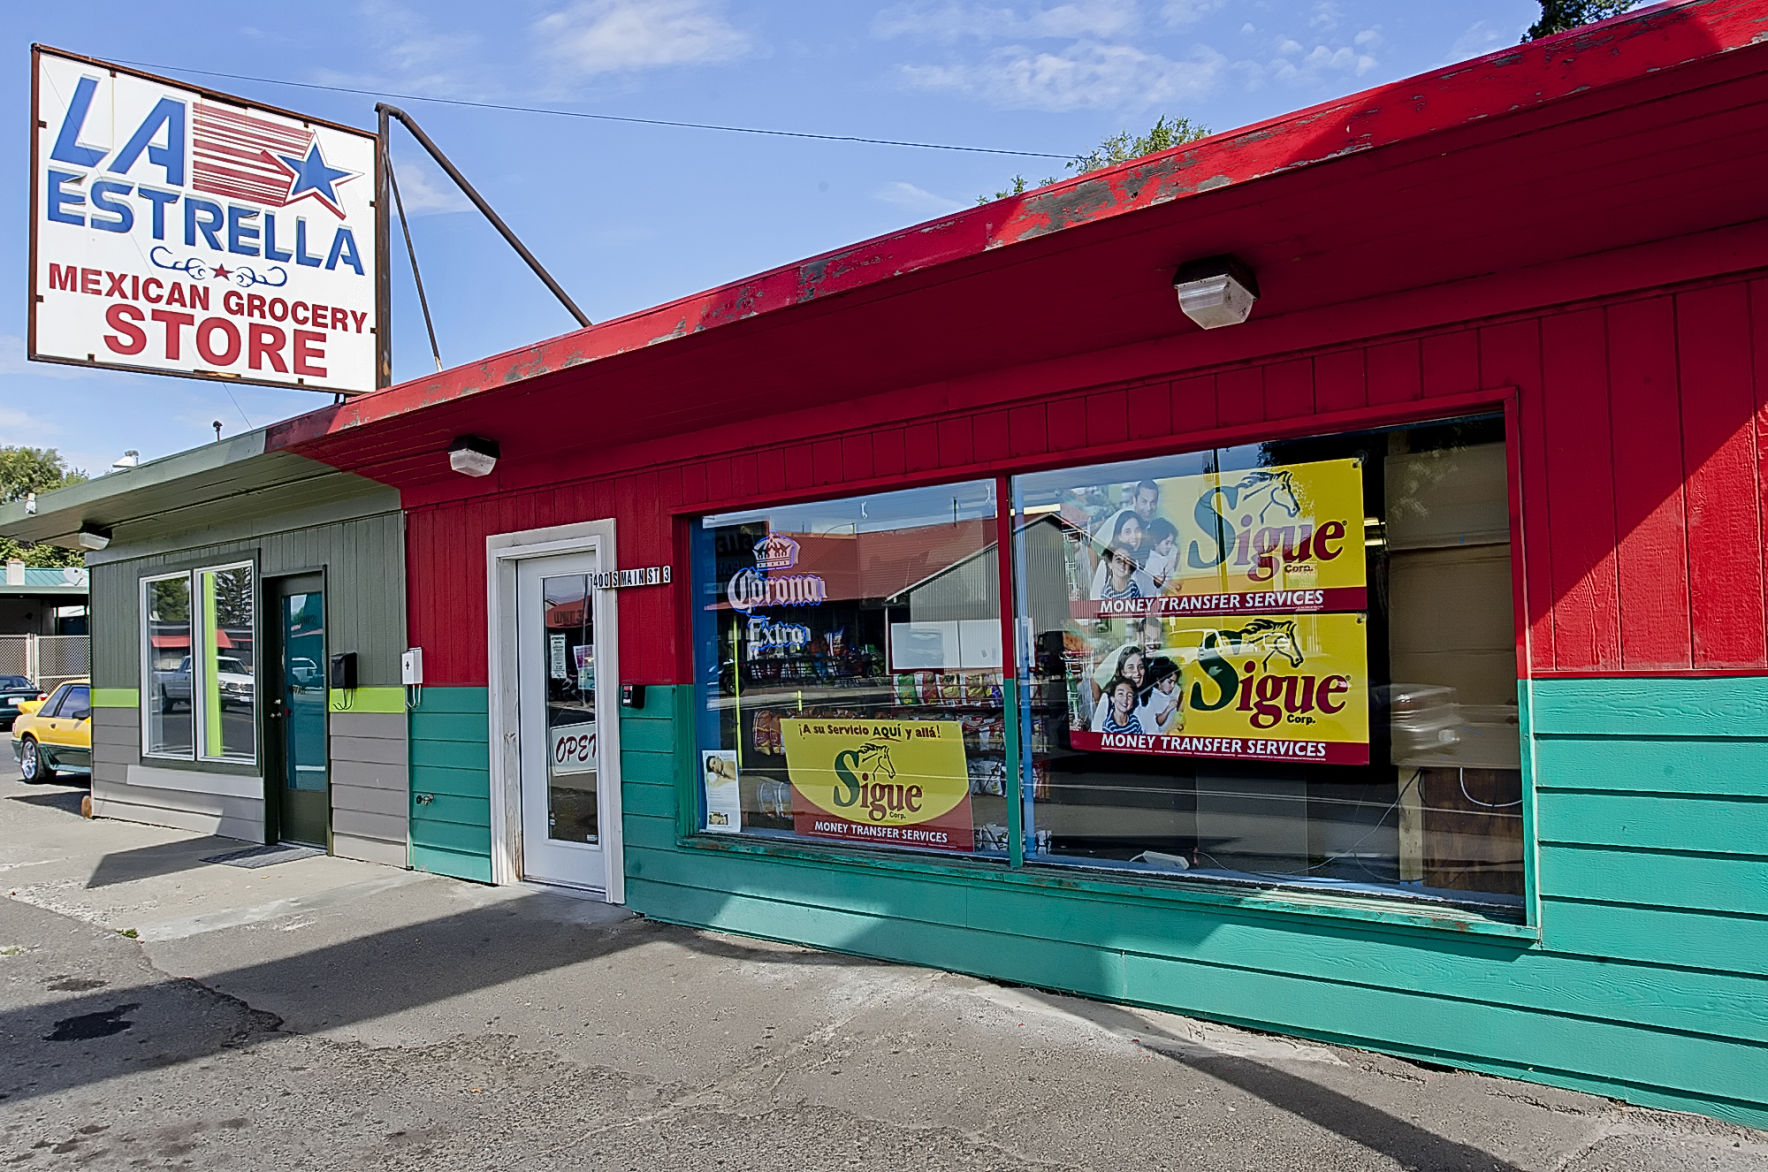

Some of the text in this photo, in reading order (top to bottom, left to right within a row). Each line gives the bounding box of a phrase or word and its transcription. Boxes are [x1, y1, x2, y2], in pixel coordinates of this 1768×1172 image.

[50, 74, 187, 187] LA
[47, 168, 365, 276] ESTRELLA
[49, 262, 368, 334] MEXICAN GROCERY
[104, 303, 328, 378] STORE
[1187, 485, 1345, 582] Sigue
[593, 566, 670, 588] 400 S MAIN ST 3
[1284, 563, 1314, 574] Corp.
[727, 568, 828, 614] Corona
[1099, 598, 1154, 613] MONEY
[1158, 593, 1240, 611] TRANSFER
[1245, 589, 1324, 607] SERVICES
[748, 617, 811, 648] Extra
[1190, 630, 1349, 729] Sigue
[814, 726, 825, 735] su
[828, 724, 870, 736] Servicio
[873, 723, 902, 739] AQUÍ
[905, 728, 912, 740] y
[915, 724, 941, 739] allá!
[1286, 714, 1316, 725] Corp.
[1101, 733, 1326, 757] MONEY TRANSFER SERVICES
[833, 750, 923, 821] Sigue
[889, 811, 906, 820] Corp.
[814, 821, 848, 834] MONEY
[851, 824, 899, 839] TRANSFER
[902, 829, 948, 843] SERVICES
